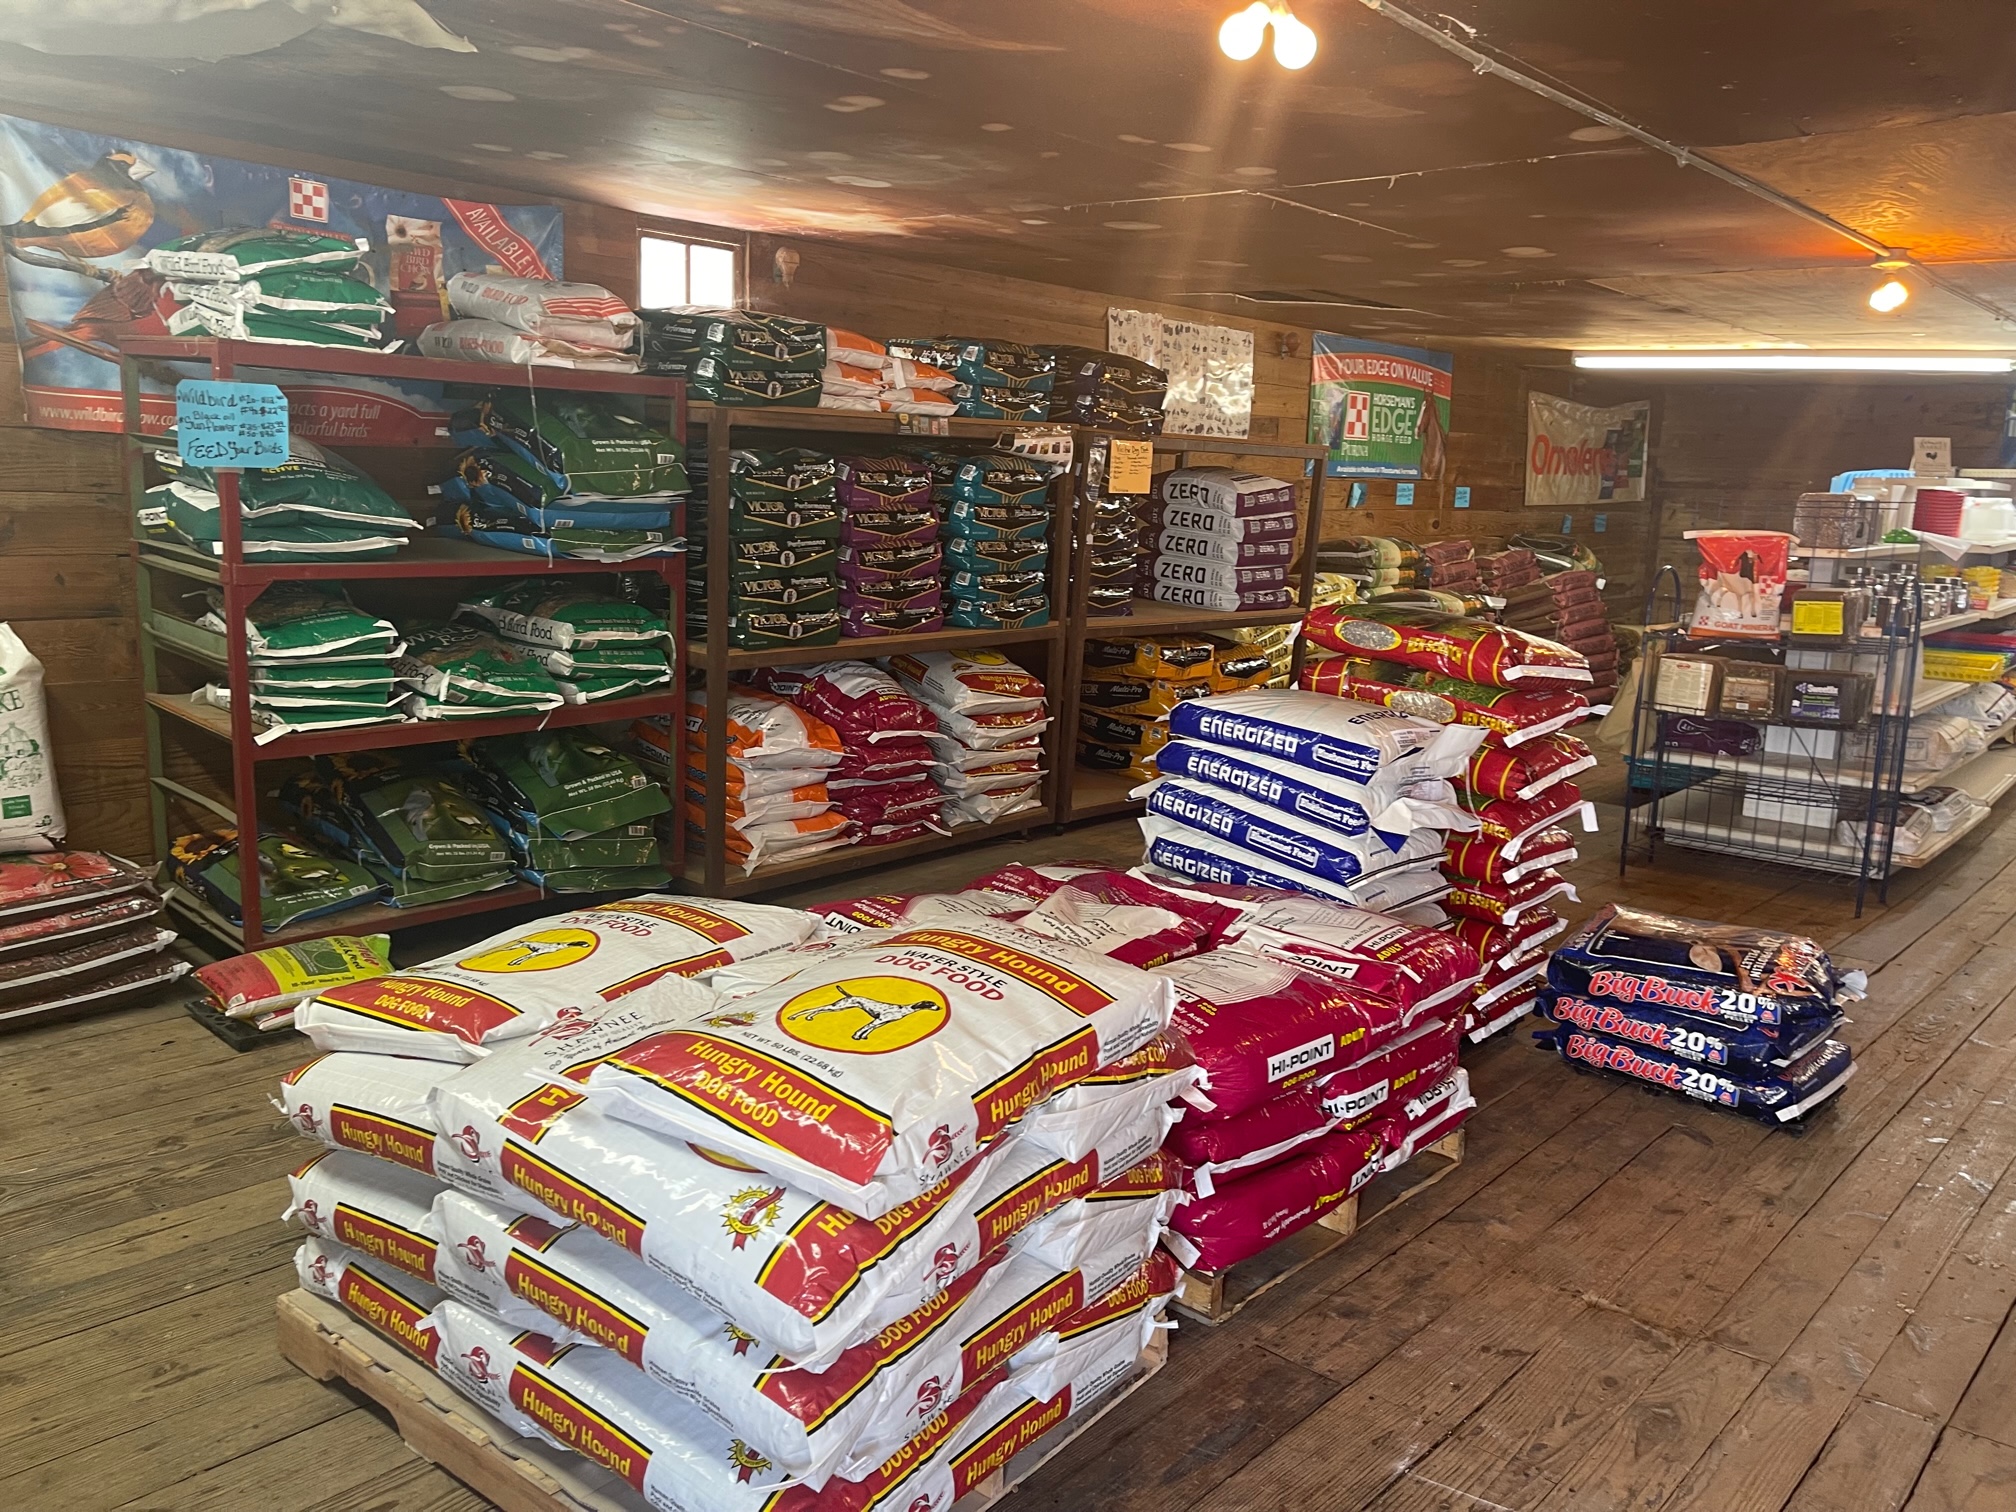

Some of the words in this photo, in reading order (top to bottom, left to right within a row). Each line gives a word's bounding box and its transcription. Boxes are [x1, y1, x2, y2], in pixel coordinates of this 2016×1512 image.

[466, 207, 531, 272] AVAILABLE
[729, 370, 768, 382] VICTOR
[1338, 358, 1366, 375] YOUR
[1368, 360, 1390, 377] EDGE
[1390, 361, 1405, 379] ON
[1405, 364, 1434, 387] VALUE
[331, 404, 363, 421] yard
[364, 405, 381, 419] full
[1373, 393, 1416, 409] HORSEMAN'S
[338, 424, 368, 438] birds
[1372, 407, 1415, 436] EDGE
[187, 438, 229, 459] FEED
[1395, 435, 1412, 444] FEED
[261, 465, 301, 475] ACTIVE
[748, 501, 787, 512] VICTOR
[794, 502, 832, 510] Performance
[1169, 483, 1209, 504] ZERO
[856, 513, 892, 524] VICTOR
[978, 506, 1008, 518] VICTOR
[1170, 510, 1215, 531] ZERO
[740, 541, 780, 556] VICTOR
[787, 539, 826, 548] Performance
[863, 551, 897, 563] VICTOR
[976, 541, 1008, 552] VICTOR
[1165, 535, 1209, 557] ZERO
[743, 579, 784, 593] VICTOR
[791, 577, 828, 585] Performance
[1160, 562, 1207, 584] ZERO
[1161, 585, 1205, 605] ZERO
[531, 623, 553, 641] Food
[1714, 621, 1739, 630] GOAT
[1110, 685, 1143, 694] Multi-Pro
[1107, 722, 1136, 736] Multi-Pro
[1200, 716, 1300, 754] ENERGIZED
[1096, 749, 1125, 761] Multi-Pro
[1187, 755, 1283, 802] ENERGIZED
[1152, 790, 1235, 834] NERGIZED
[1154, 849, 1233, 886] NERGIZED
[599, 920, 652, 938] FOOD
[621, 915, 659, 929] STYLE
[652, 903, 723, 930] Hound
[1368, 926, 1407, 949] HI-POINT
[1376, 943, 1404, 961] ADULT
[874, 954, 932, 972] DOG
[930, 966, 1005, 1001] FOOD
[902, 931, 990, 955] Hungry
[989, 950, 1080, 995] Hound
[902, 949, 958, 968] WAFER
[956, 964, 1008, 989] STYLE
[378, 978, 425, 998] Hungry
[424, 985, 475, 1009] Hound
[1588, 970, 1641, 1003] Big
[1640, 974, 1721, 1016] Buck
[1719, 990, 1776, 1015] 20%
[1553, 996, 1600, 1031] Big
[1599, 1006, 1673, 1051] Buck
[1670, 1027, 1724, 1052] 20%
[771, 1042, 784, 1050] 50
[827, 1066, 845, 1079] kg)
[1271, 1041, 1333, 1077] HI-POINT
[1566, 1033, 1611, 1069] Big
[1610, 1044, 1684, 1091] Buck
[1681, 1067, 1736, 1095] 20%
[686, 1041, 763, 1083] Hungry
[758, 1071, 838, 1123] Hound
[990, 1074, 1041, 1123] Hungry
[1040, 1045, 1089, 1080] Hound
[695, 1070, 733, 1101] DOG
[730, 1089, 780, 1128] FOOD
[1321, 1085, 1387, 1119] HI-POINT
[341, 1120, 384, 1151] Hungry
[385, 1132, 425, 1164] Hound
[513, 1163, 569, 1214] Hungry
[991, 1191, 1042, 1239] Hungry
[1044, 1164, 1090, 1201] Hound
[874, 1202, 914, 1236] DOG
[348, 1282, 389, 1325] Hungry
[390, 1309, 431, 1352] Hound
[517, 1272, 573, 1322] Hungry
[576, 1306, 630, 1354] Hound
[875, 1316, 914, 1350] DOG
[909, 1288, 949, 1325] FOOD
[976, 1319, 1027, 1370] Hungry
[1030, 1287, 1074, 1328] Hound
[522, 1387, 578, 1441] Hungry
[580, 1425, 632, 1478] Hound
[966, 1433, 1018, 1486] Hungry
[1020, 1398, 1063, 1443] Hound
[880, 1441, 914, 1479] DOG
